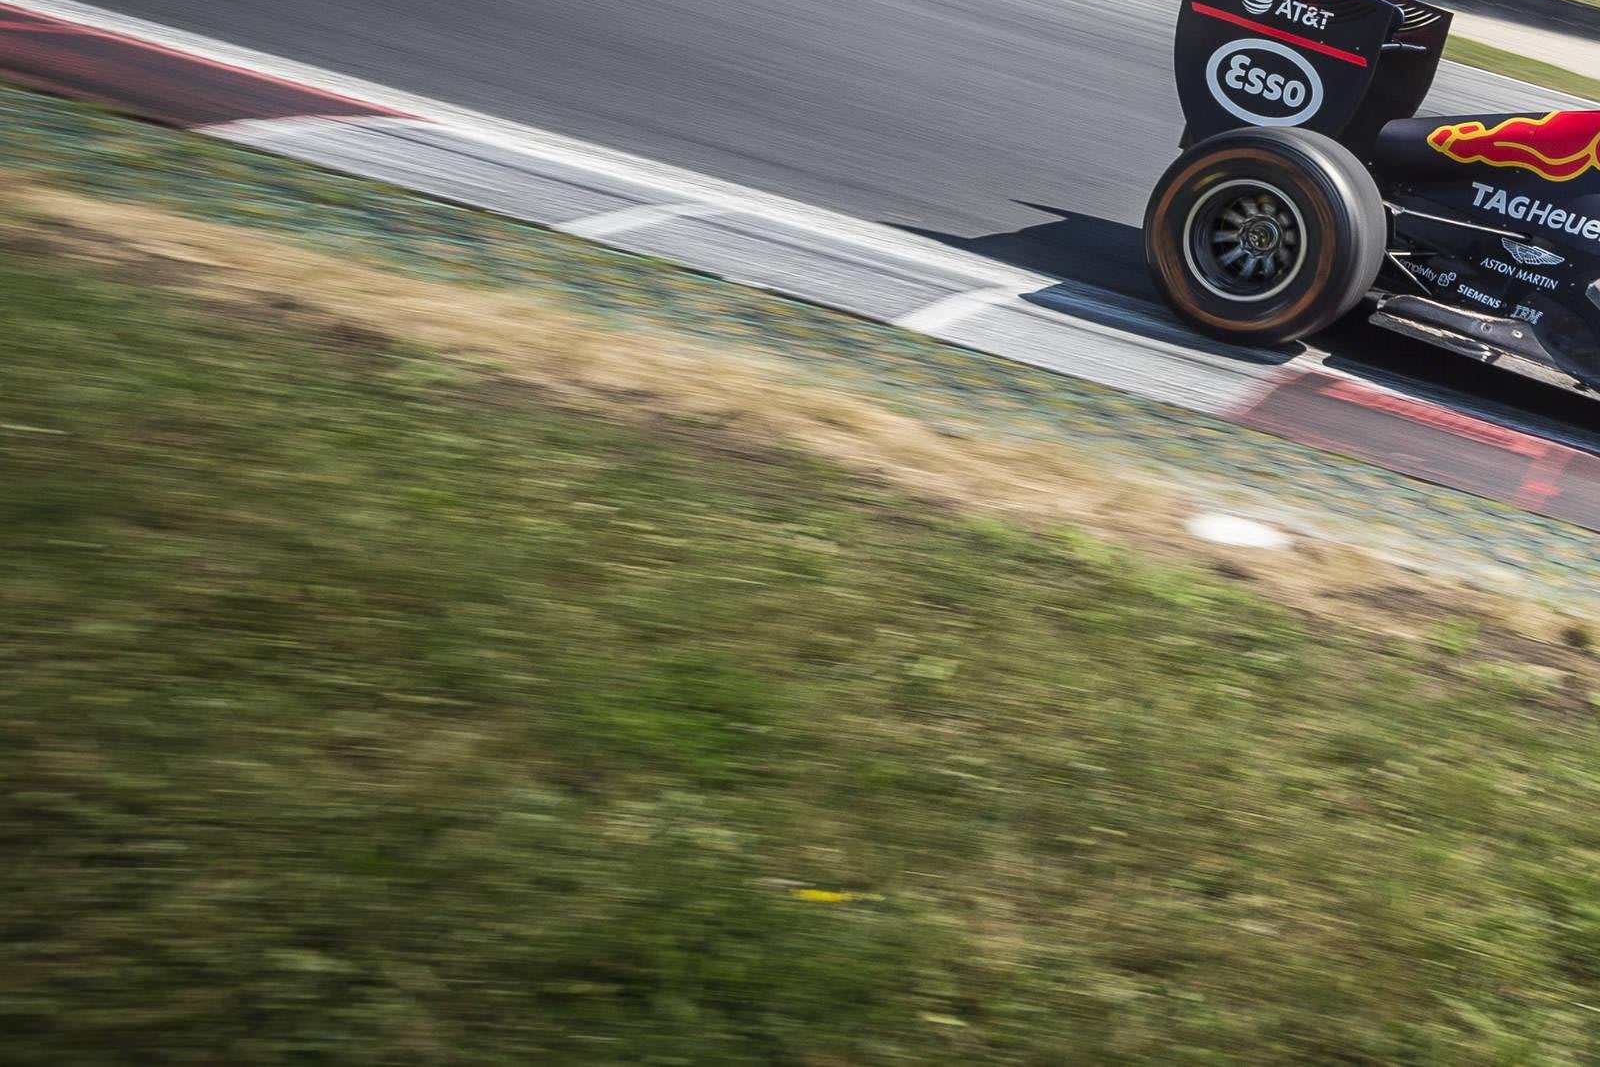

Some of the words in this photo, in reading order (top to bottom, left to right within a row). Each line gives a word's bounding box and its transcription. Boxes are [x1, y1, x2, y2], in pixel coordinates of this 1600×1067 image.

[1480, 257, 1517, 279] ASTON
[1515, 267, 1559, 291] MARTIN
[1457, 284, 1502, 309] SIEMENS
[1510, 304, 1543, 325] IBM
